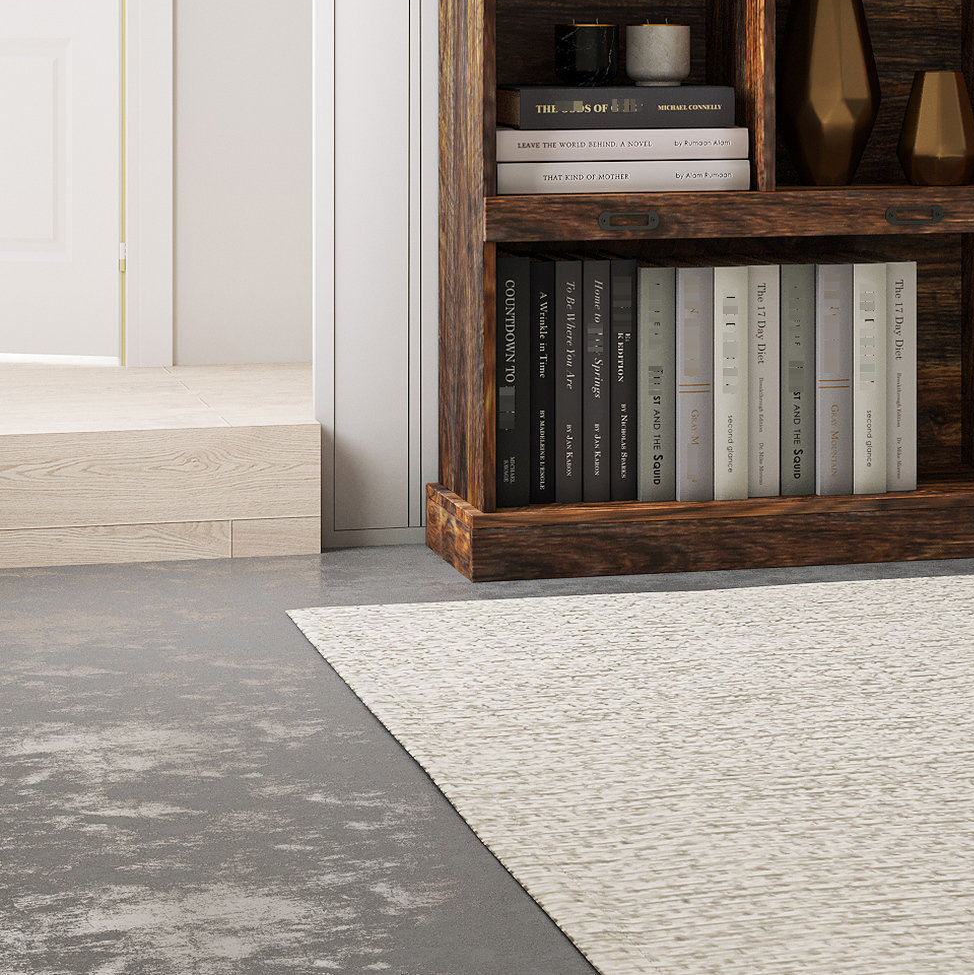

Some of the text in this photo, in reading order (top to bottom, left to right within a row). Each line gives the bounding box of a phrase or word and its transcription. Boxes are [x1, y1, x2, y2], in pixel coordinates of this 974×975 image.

[559, 141, 586, 149] WORLD
[593, 279, 603, 310] Home
[504, 279, 516, 363] COUNTDOWN
[539, 291, 548, 378] A Wrinkle in Time
[565, 280, 576, 390] To Be Where You Are
[594, 313, 602, 323] to
[755, 282, 766, 365] The 17 Day Diet
[893, 279, 904, 361] The 17 Day Diet
[504, 365, 516, 383] TO
[591, 358, 603, 398] Springs
[726, 445, 734, 473] glance
